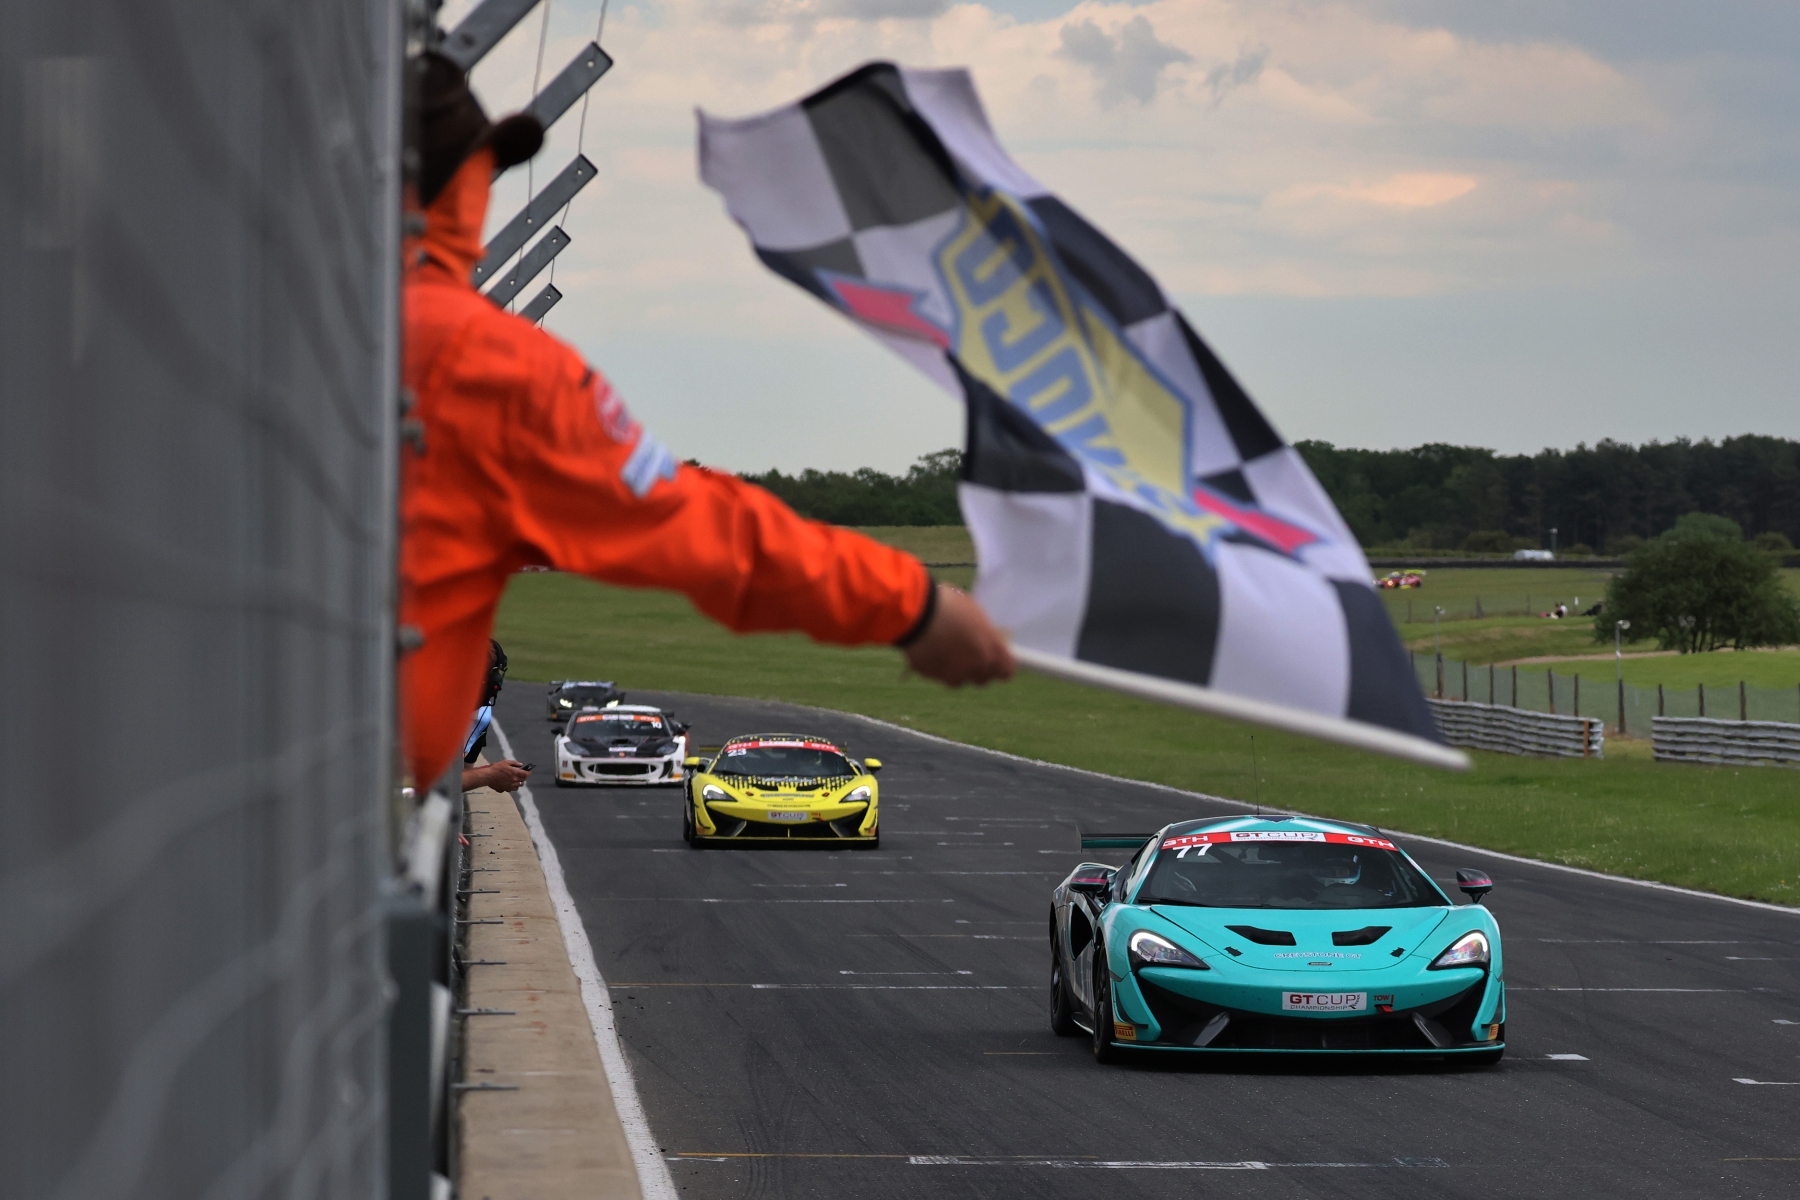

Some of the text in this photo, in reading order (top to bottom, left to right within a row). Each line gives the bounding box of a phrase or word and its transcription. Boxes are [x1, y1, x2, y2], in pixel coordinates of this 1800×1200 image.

[727, 748, 747, 757] 23
[1162, 836, 1209, 847] GTH
[1347, 836, 1395, 848] GTH
[1172, 843, 1213, 859] 77
[1289, 993, 1314, 1005] GT
[1316, 994, 1357, 1005] CUP
